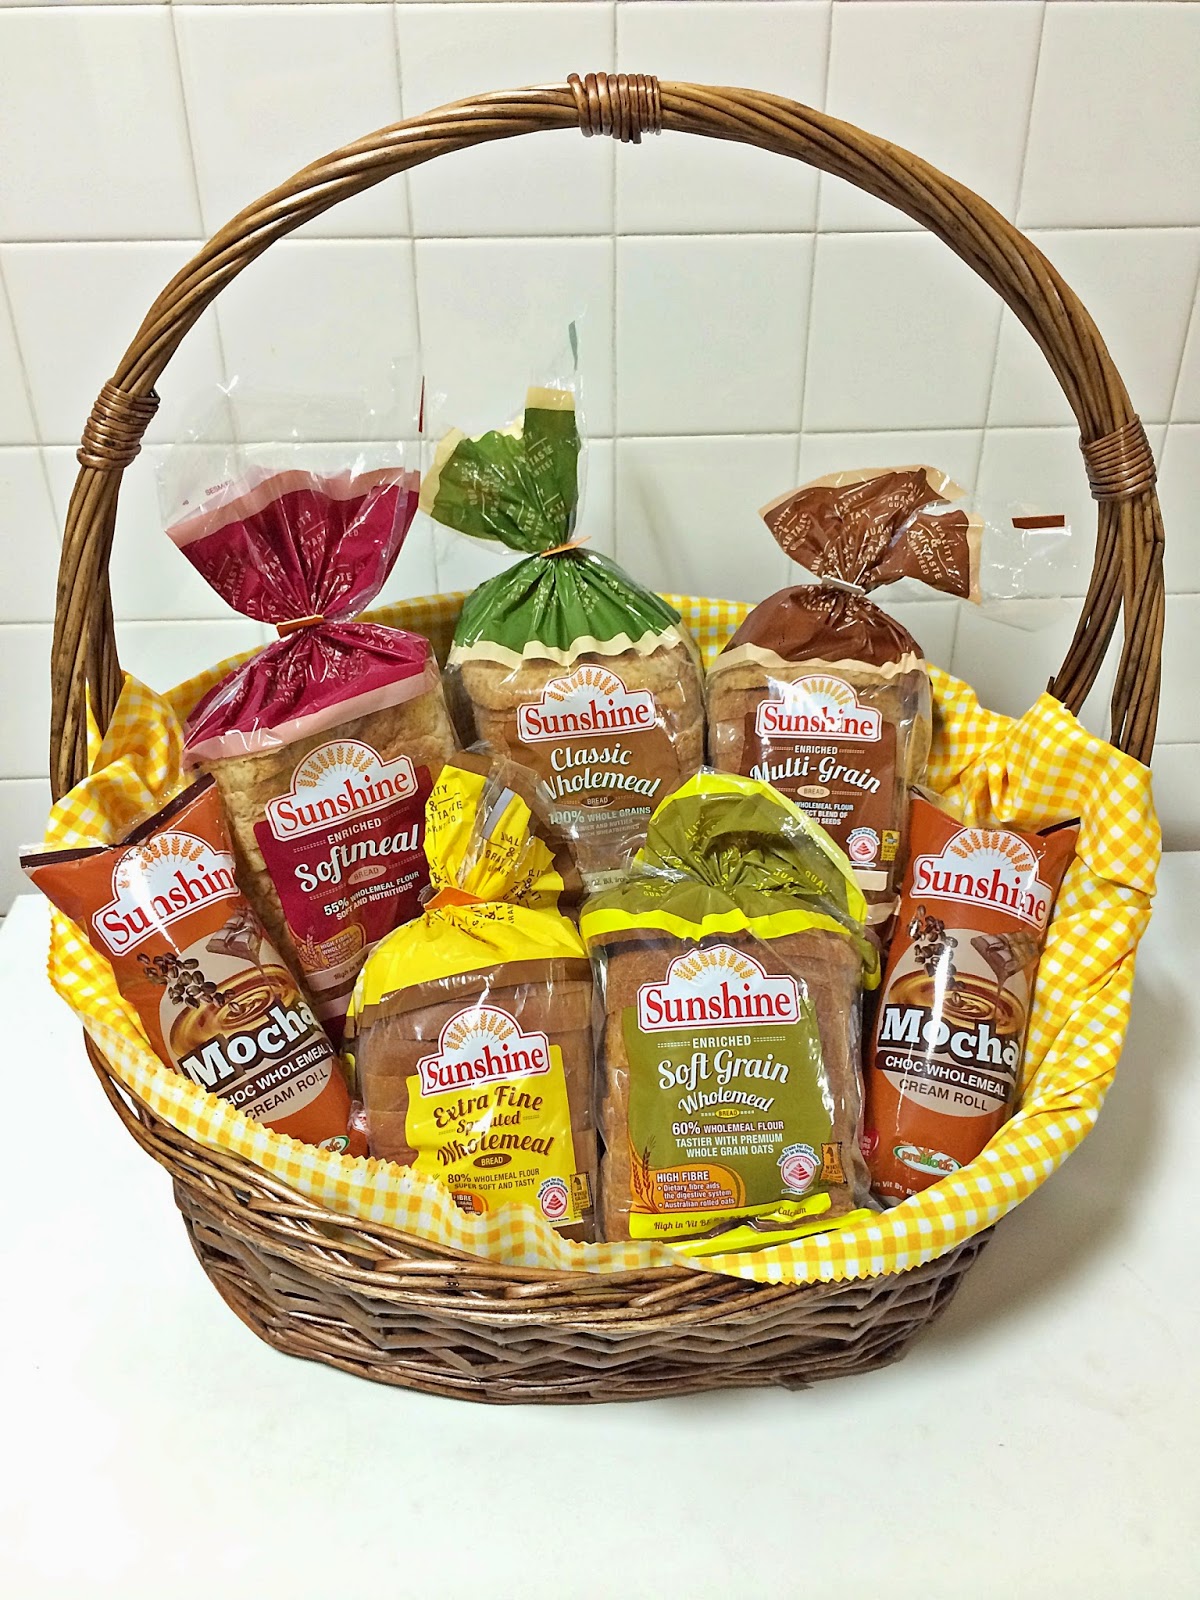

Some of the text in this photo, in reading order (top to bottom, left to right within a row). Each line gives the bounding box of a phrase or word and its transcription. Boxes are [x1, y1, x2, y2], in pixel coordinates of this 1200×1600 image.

[525, 698, 650, 735] Sunshine
[550, 743, 632, 771] Classic
[794, 745, 838, 754] ENRICHED
[750, 756, 881, 794] Multi-Grain
[276, 771, 411, 833] Sunshine
[586, 796, 608, 805] BREAD
[803, 787, 825, 795] BREAD
[587, 811, 618, 822] WHOLE
[619, 807, 651, 818] GRAINS
[818, 810, 838, 818] BLEND
[834, 803, 854, 811] FLOUR
[327, 817, 382, 845] ENRICHED
[294, 823, 419, 893] Softmeal
[354, 867, 379, 880] BREAD
[102, 863, 236, 945] Sunshin
[323, 871, 420, 916] 55% WHOLEMEAL FLOUR
[336, 882, 414, 920] SOFT AND NUTRITIOUS
[916, 859, 1046, 922] Sunshine
[645, 981, 792, 1024] Sunshine
[182, 1001, 315, 1088] Mocha
[692, 1035, 751, 1048] ENRICHED
[880, 1007, 1019, 1072] Mocha
[226, 1045, 329, 1106] HOC WHOLEMEAL
[426, 1043, 544, 1090] Sunshine
[657, 1049, 789, 1091] Soft Grain
[885, 1055, 1006, 1097] CHOC WHOLEMEAL
[245, 1068, 328, 1120] CREAM ROLL
[433, 1085, 543, 1128] Extra Fine
[678, 1087, 775, 1115] Wholemeal
[899, 1078, 988, 1111] CREAM ROLL
[456, 1111, 521, 1136] Sputed
[672, 1121, 784, 1136] 60% WHOLEMEAL FLOUR
[437, 1131, 555, 1166] Wholemeal
[675, 1133, 783, 1148] TASTIER WITH PREMIUM
[686, 1144, 774, 1158] WHOLE GRAIN OATS
[481, 1156, 503, 1166] BREAD
[447, 1168, 540, 1184] 80% WHOLEMEAL FLOUR
[498, 1181, 513, 1189] AND
[515, 1178, 535, 1187] TASTY
[656, 1171, 709, 1183] HIGH FIBRE
[663, 1183, 687, 1192] Dietary
[664, 1190, 732, 1200] the digestive system
[664, 1200, 698, 1208] Australian
[700, 1199, 719, 1207] rolled
[654, 1222, 673, 1231] High
